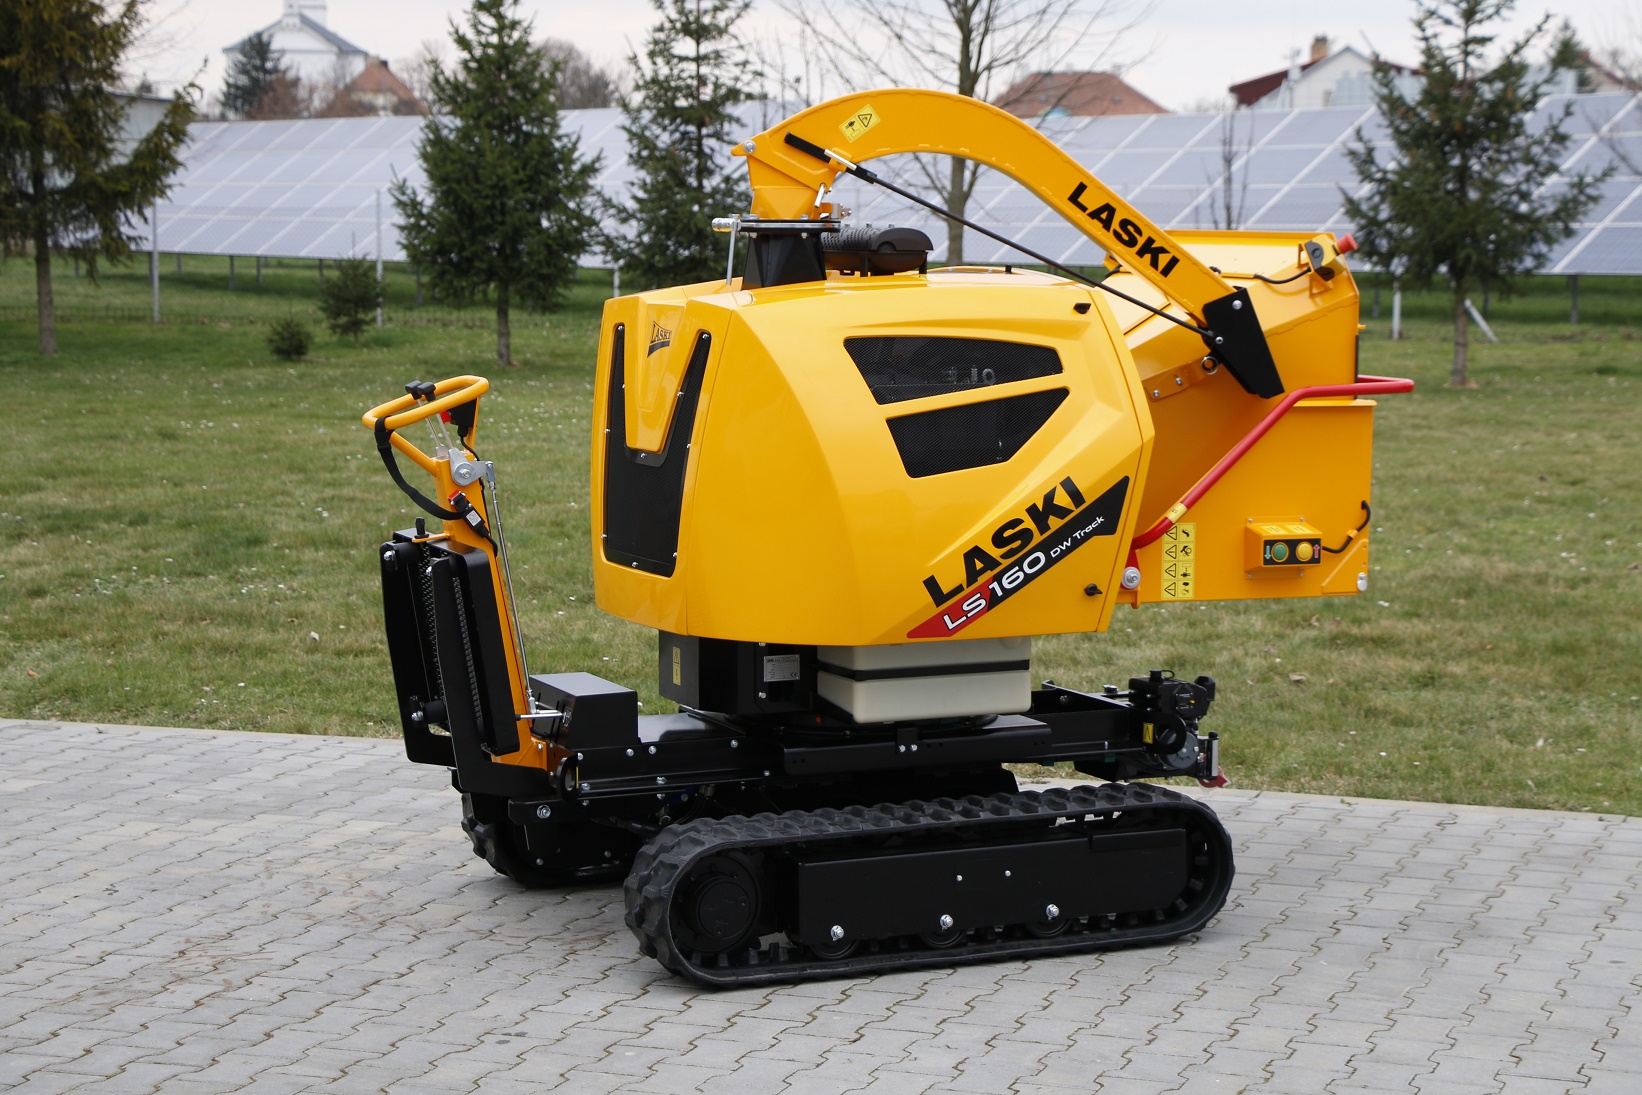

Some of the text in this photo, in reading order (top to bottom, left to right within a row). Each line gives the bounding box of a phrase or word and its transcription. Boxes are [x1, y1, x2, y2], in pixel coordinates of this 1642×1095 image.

[1067, 181, 1180, 278] LASKI
[650, 323, 671, 344] LASKI
[922, 476, 1086, 608] LASKI
[943, 516, 1104, 630] LS 160 DW Track
